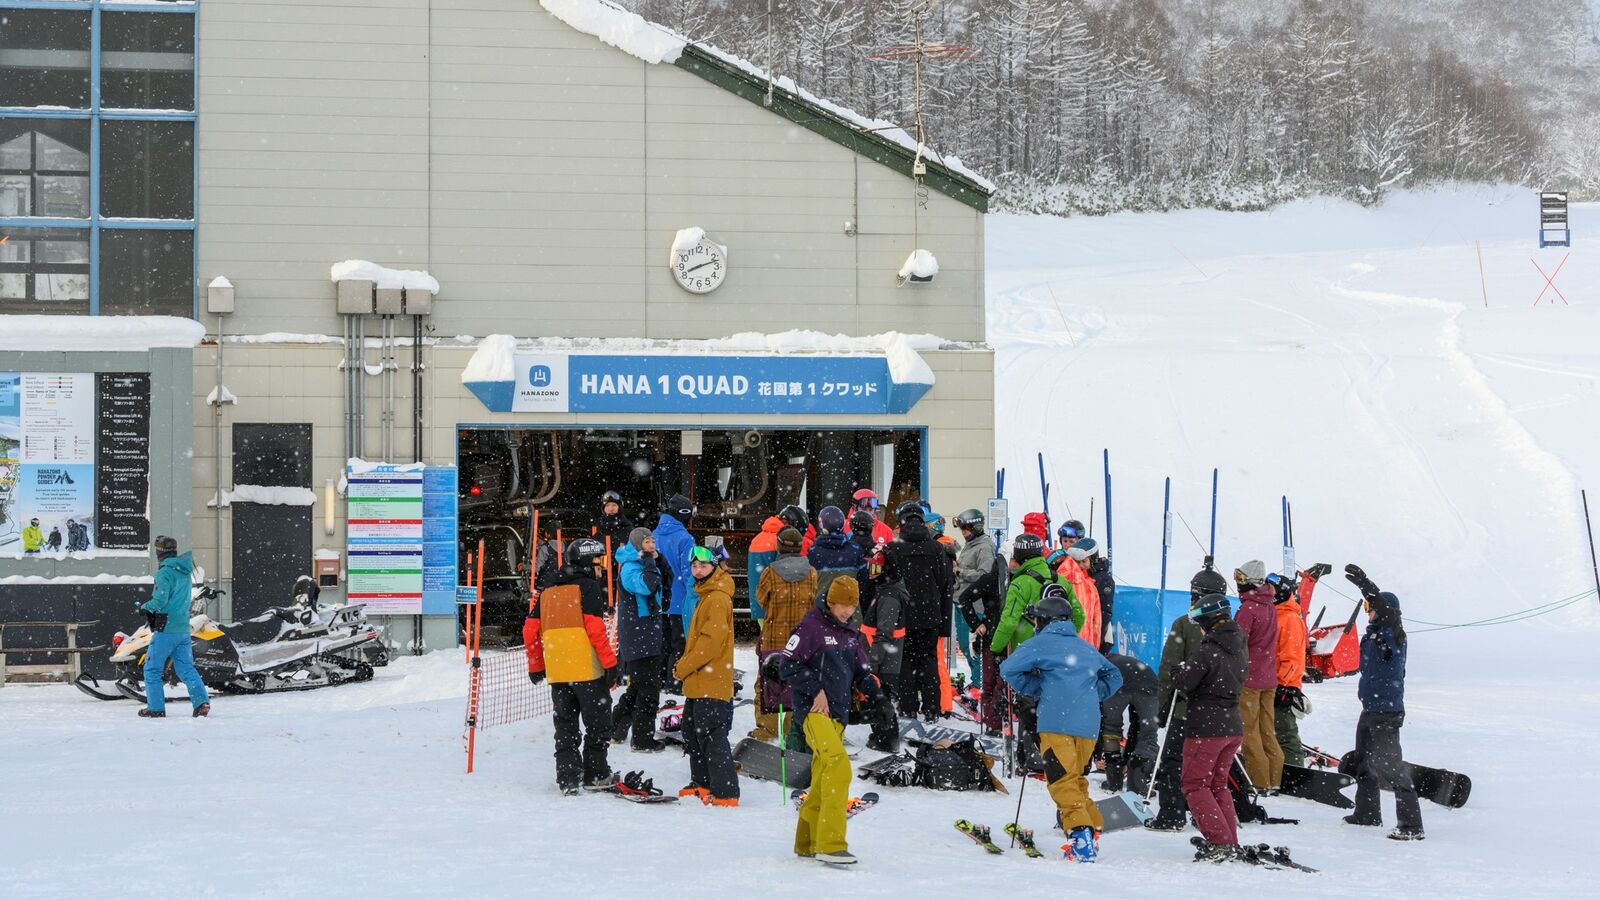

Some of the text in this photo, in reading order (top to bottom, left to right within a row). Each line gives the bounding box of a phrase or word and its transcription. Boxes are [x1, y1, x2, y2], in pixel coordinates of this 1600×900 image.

[680, 254, 688, 262] 10
[713, 262, 719, 270] 3
[681, 271, 687, 279] 8
[711, 271, 716, 279] 4
[705, 277, 710, 285] 5
[582, 374, 749, 398] HANA 1 QUAD
